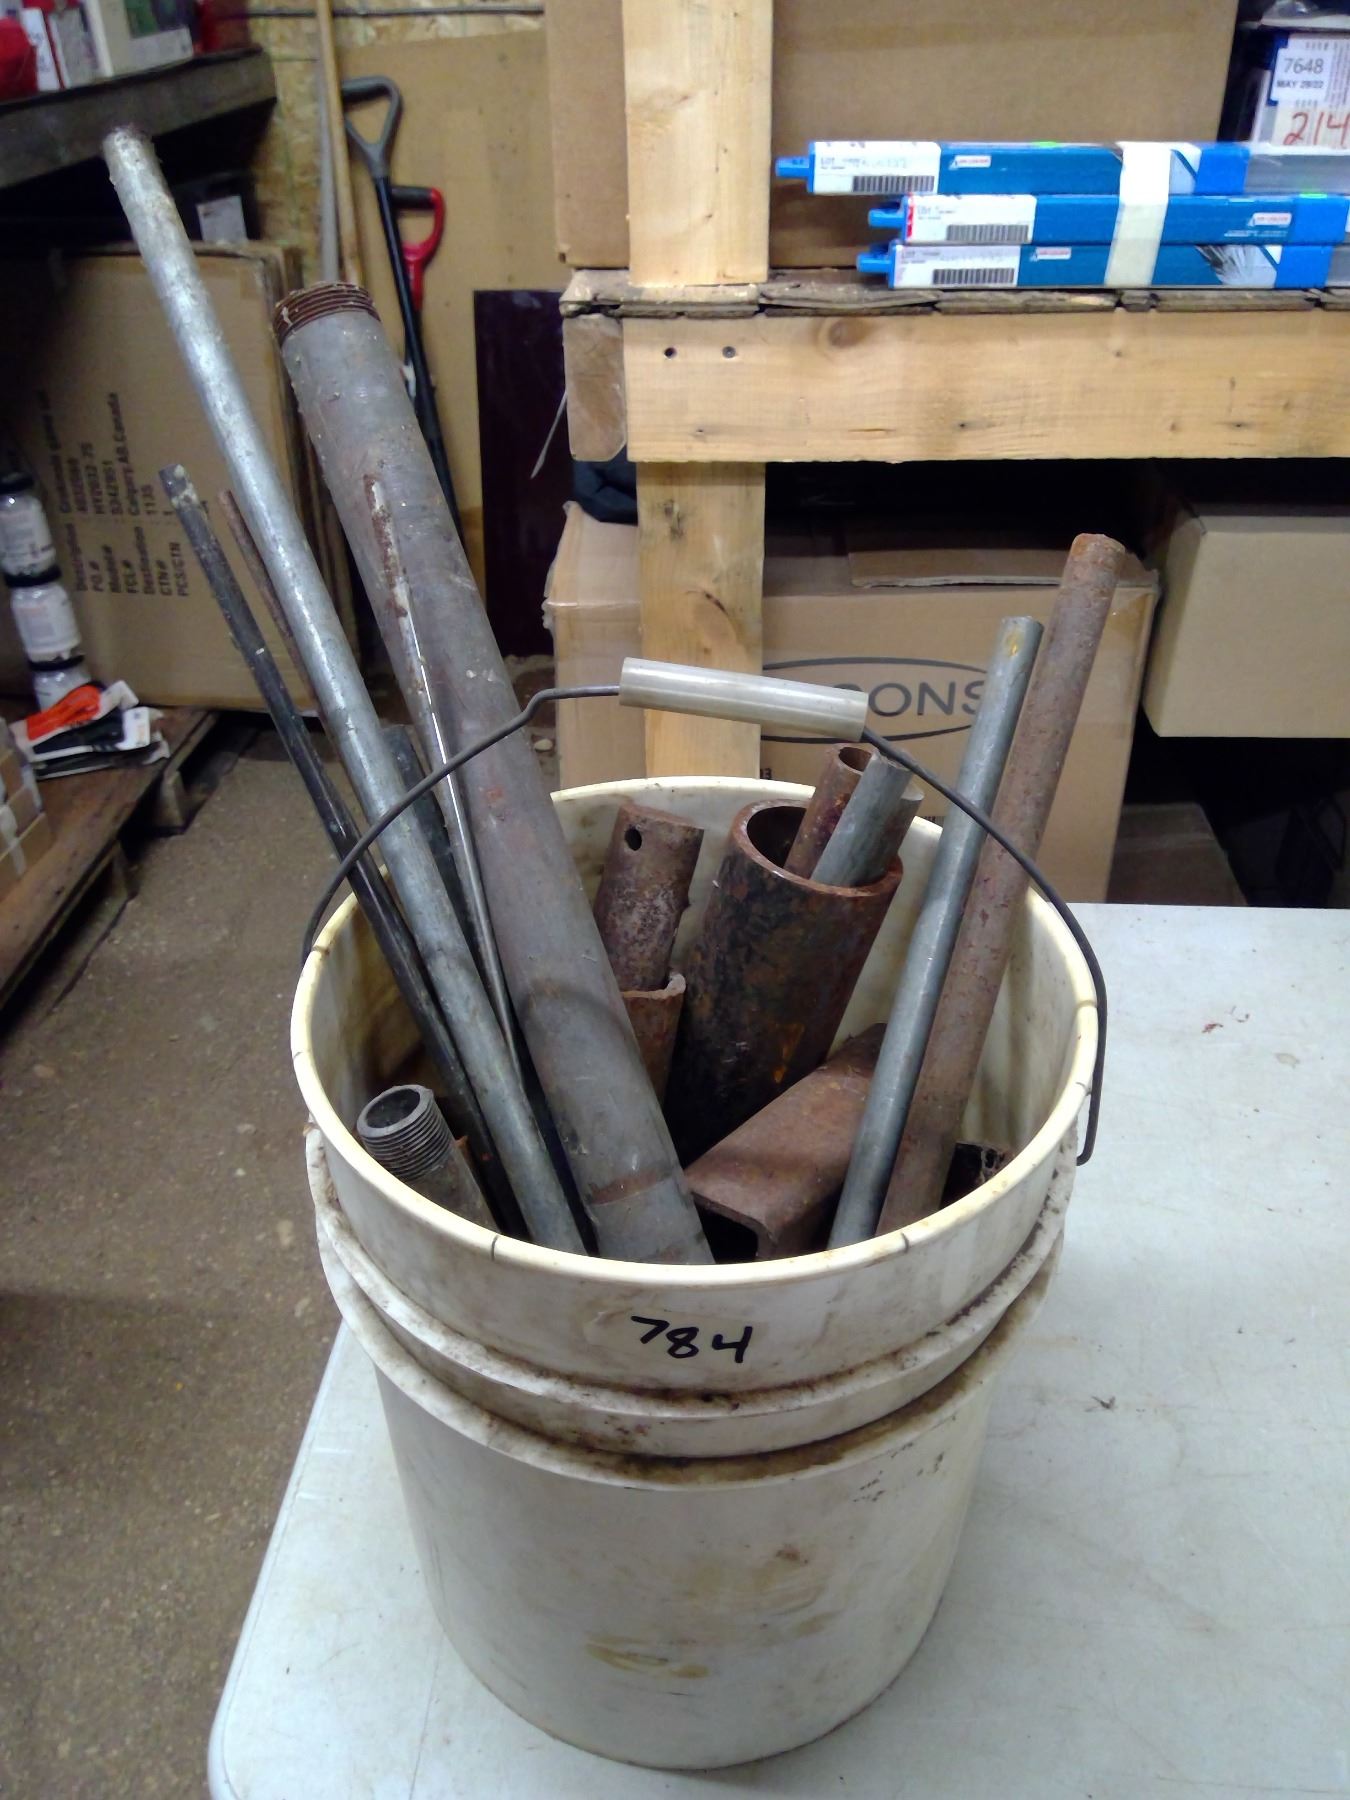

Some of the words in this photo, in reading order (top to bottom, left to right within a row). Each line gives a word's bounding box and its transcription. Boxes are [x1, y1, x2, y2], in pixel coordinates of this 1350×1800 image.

[1284, 58, 1324, 74] 7648
[1283, 111, 1350, 146] 214
[631, 1316, 753, 1364] 784
